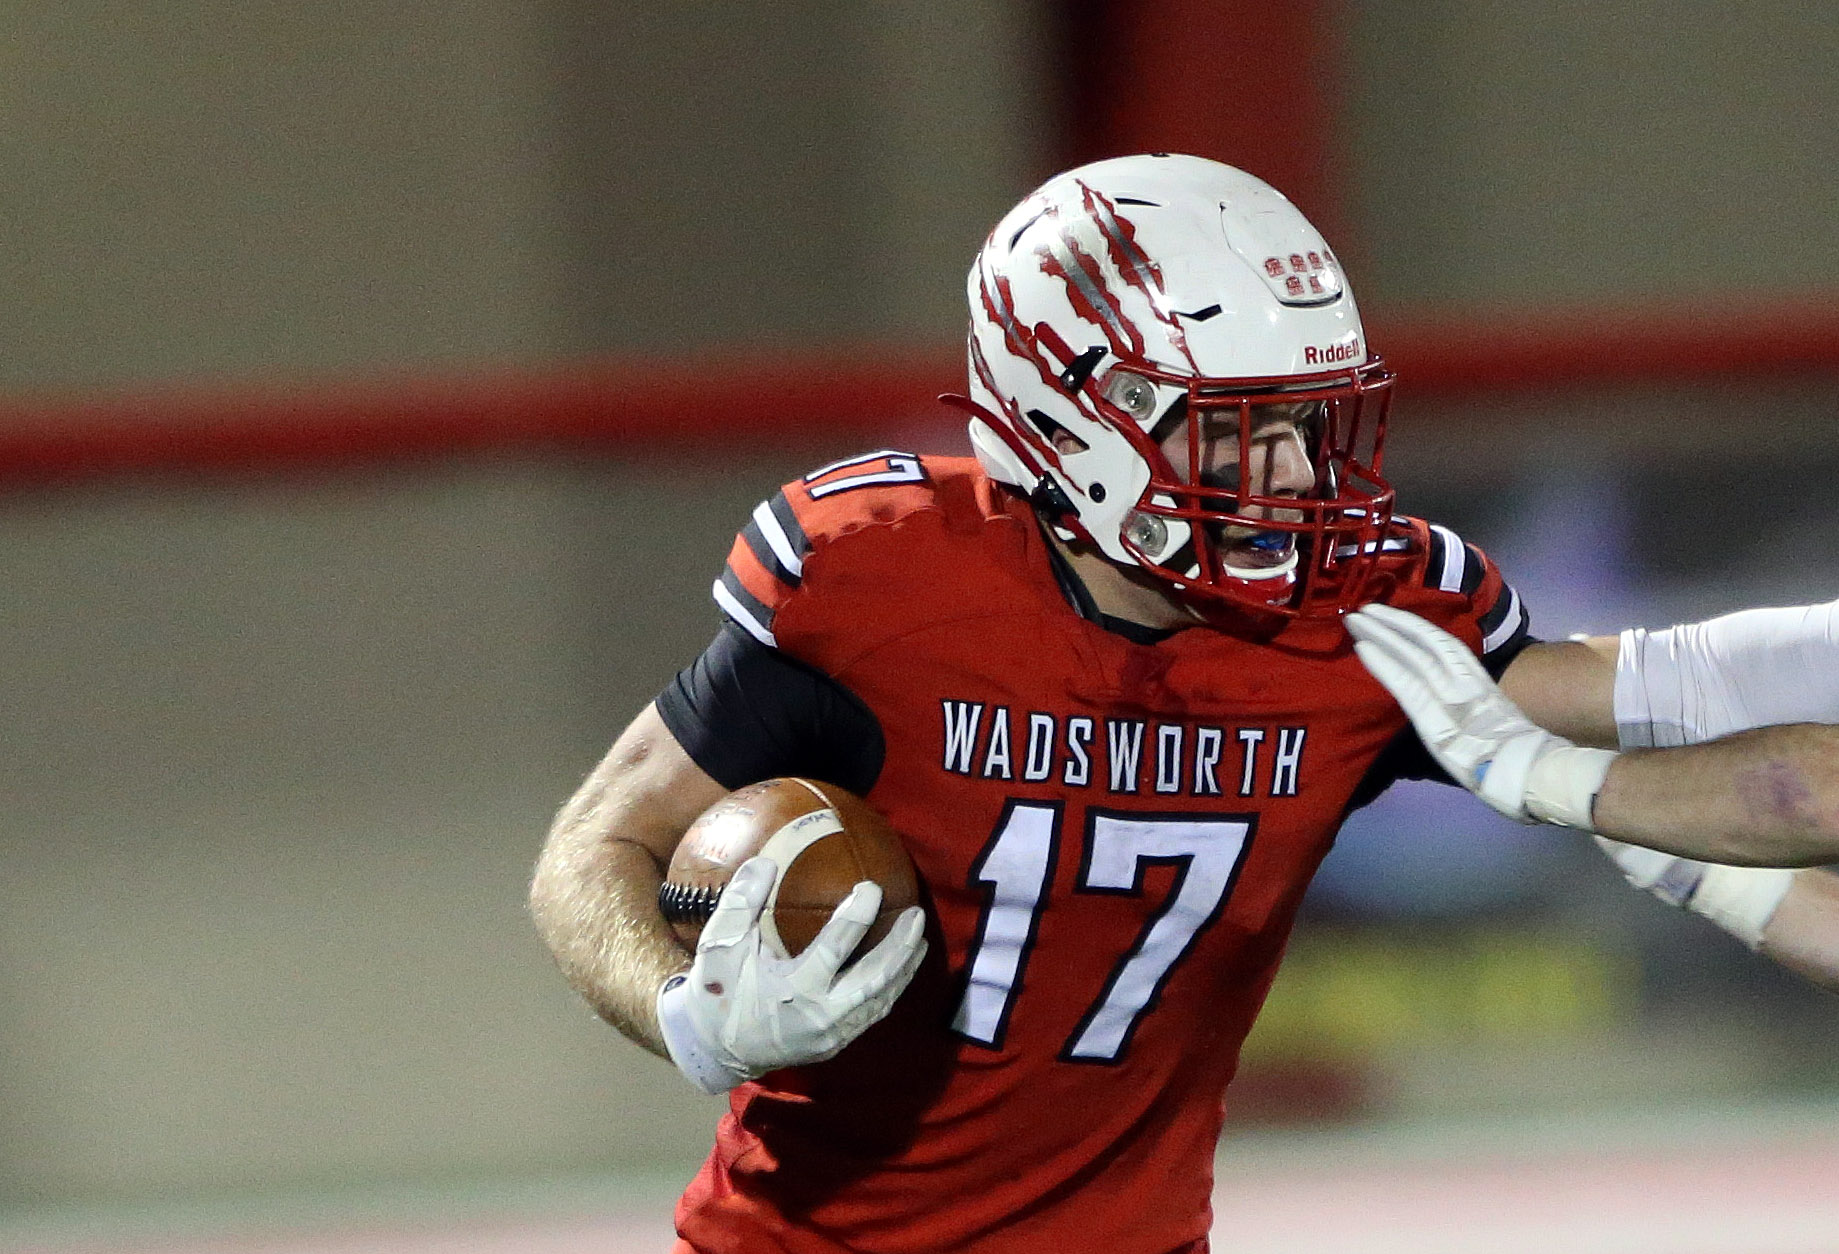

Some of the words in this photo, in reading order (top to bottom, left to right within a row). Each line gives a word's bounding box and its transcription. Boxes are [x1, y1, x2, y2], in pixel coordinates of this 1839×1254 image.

[1304, 338, 1360, 365] Riddell
[803, 450, 930, 501] 17
[942, 700, 1306, 796] WADSWORTH
[949, 798, 1260, 1064] 17
